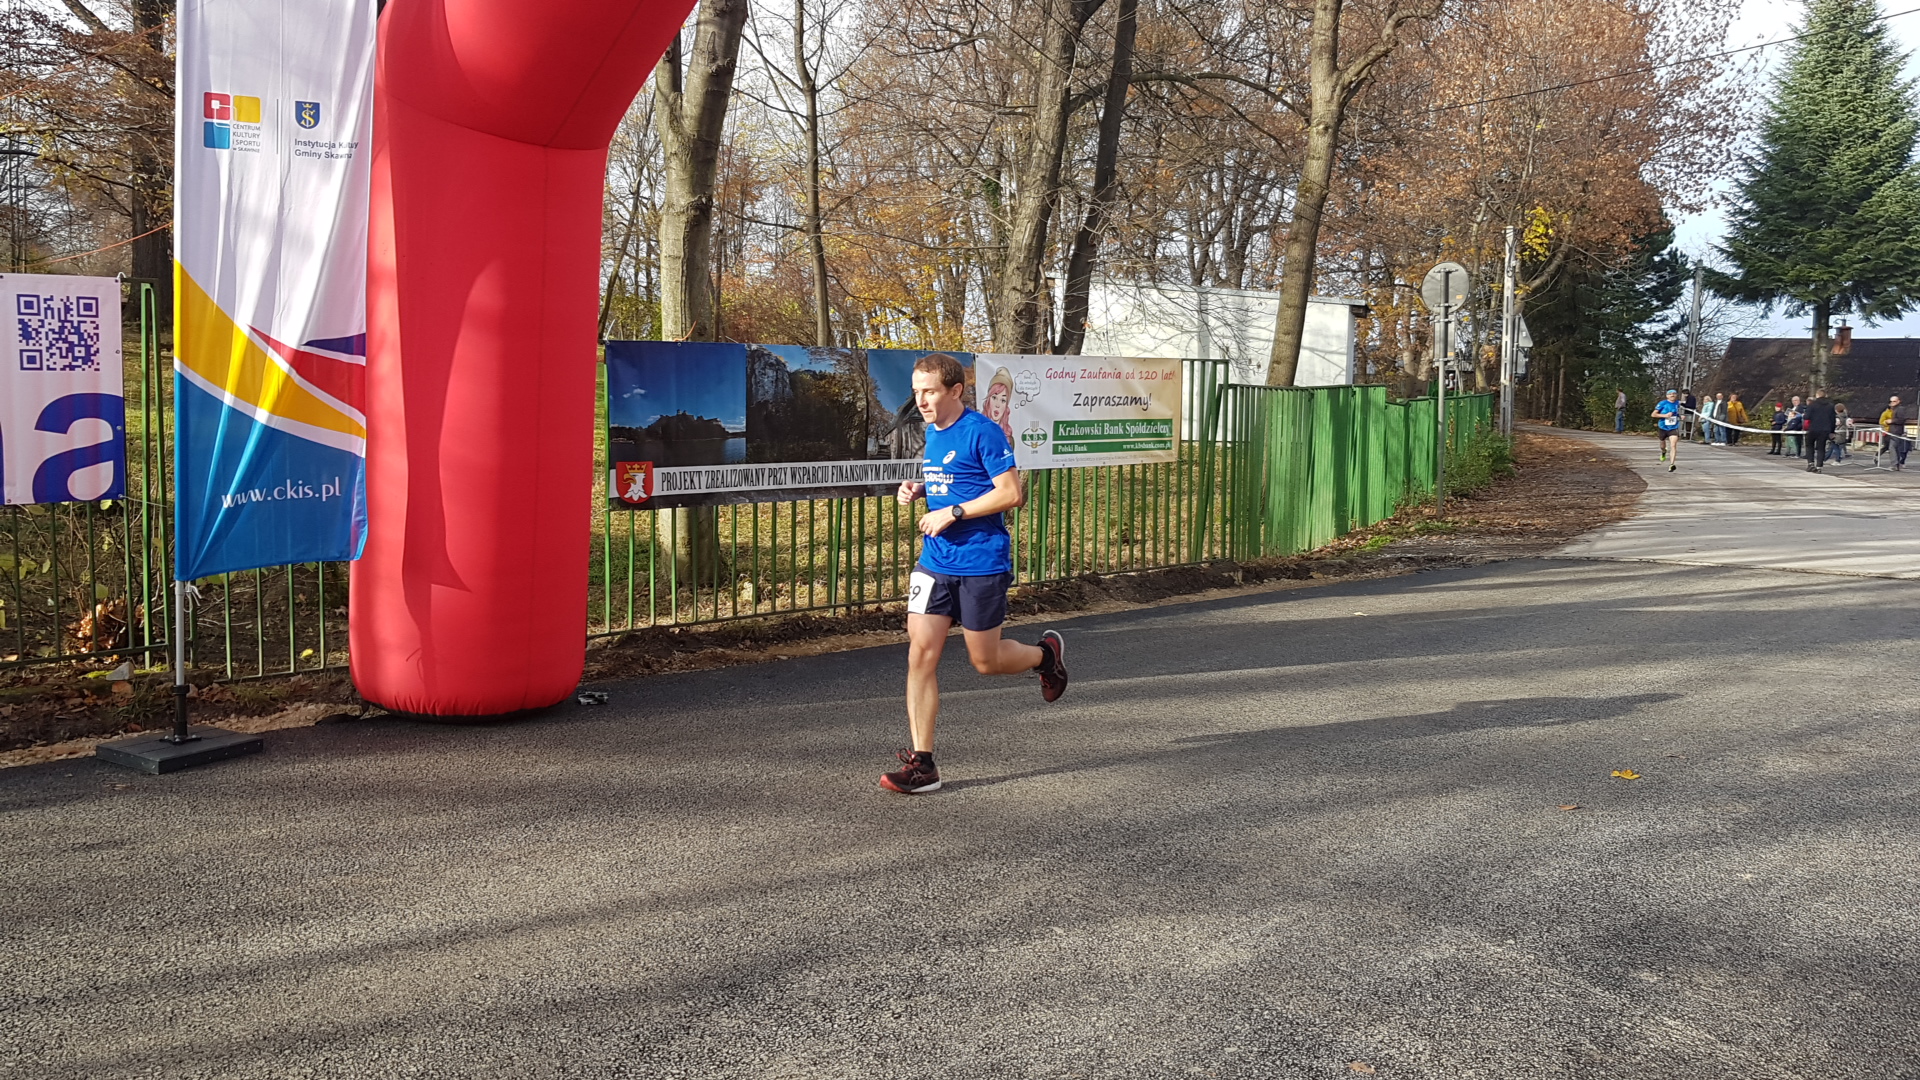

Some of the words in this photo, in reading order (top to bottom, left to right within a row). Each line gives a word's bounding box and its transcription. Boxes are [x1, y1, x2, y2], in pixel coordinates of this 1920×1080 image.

[232, 123, 261, 131] CENTRUM
[232, 131, 260, 139] KULTURY
[236, 139, 261, 147] SPORTU
[295, 138, 336, 150] Instytucja
[294, 149, 322, 160] Gminy
[1045, 367, 1077, 383] Godny
[1080, 367, 1121, 380] Zaufania
[1125, 367, 1135, 380] od
[1138, 369, 1158, 380] 120
[1161, 368, 1176, 381] lat!
[1072, 392, 1152, 413] Zapraszamy!
[1058, 423, 1102, 436] Krakowski
[1103, 422, 1124, 435] Bank
[1125, 421, 1171, 437] Spółdzielczy
[1074, 444, 1088, 452] Bank
[661, 470, 703, 492] PROJEKT
[704, 467, 767, 490] ZREALIZOWANY
[768, 466, 789, 486] PRZY
[790, 465, 830, 485] WSPARCIU
[831, 462, 881, 483] FINANSOWYM
[882, 461, 916, 481] POWIATU
[221, 476, 342, 509] www.ckis.pl
[910, 584, 921, 601] 9
